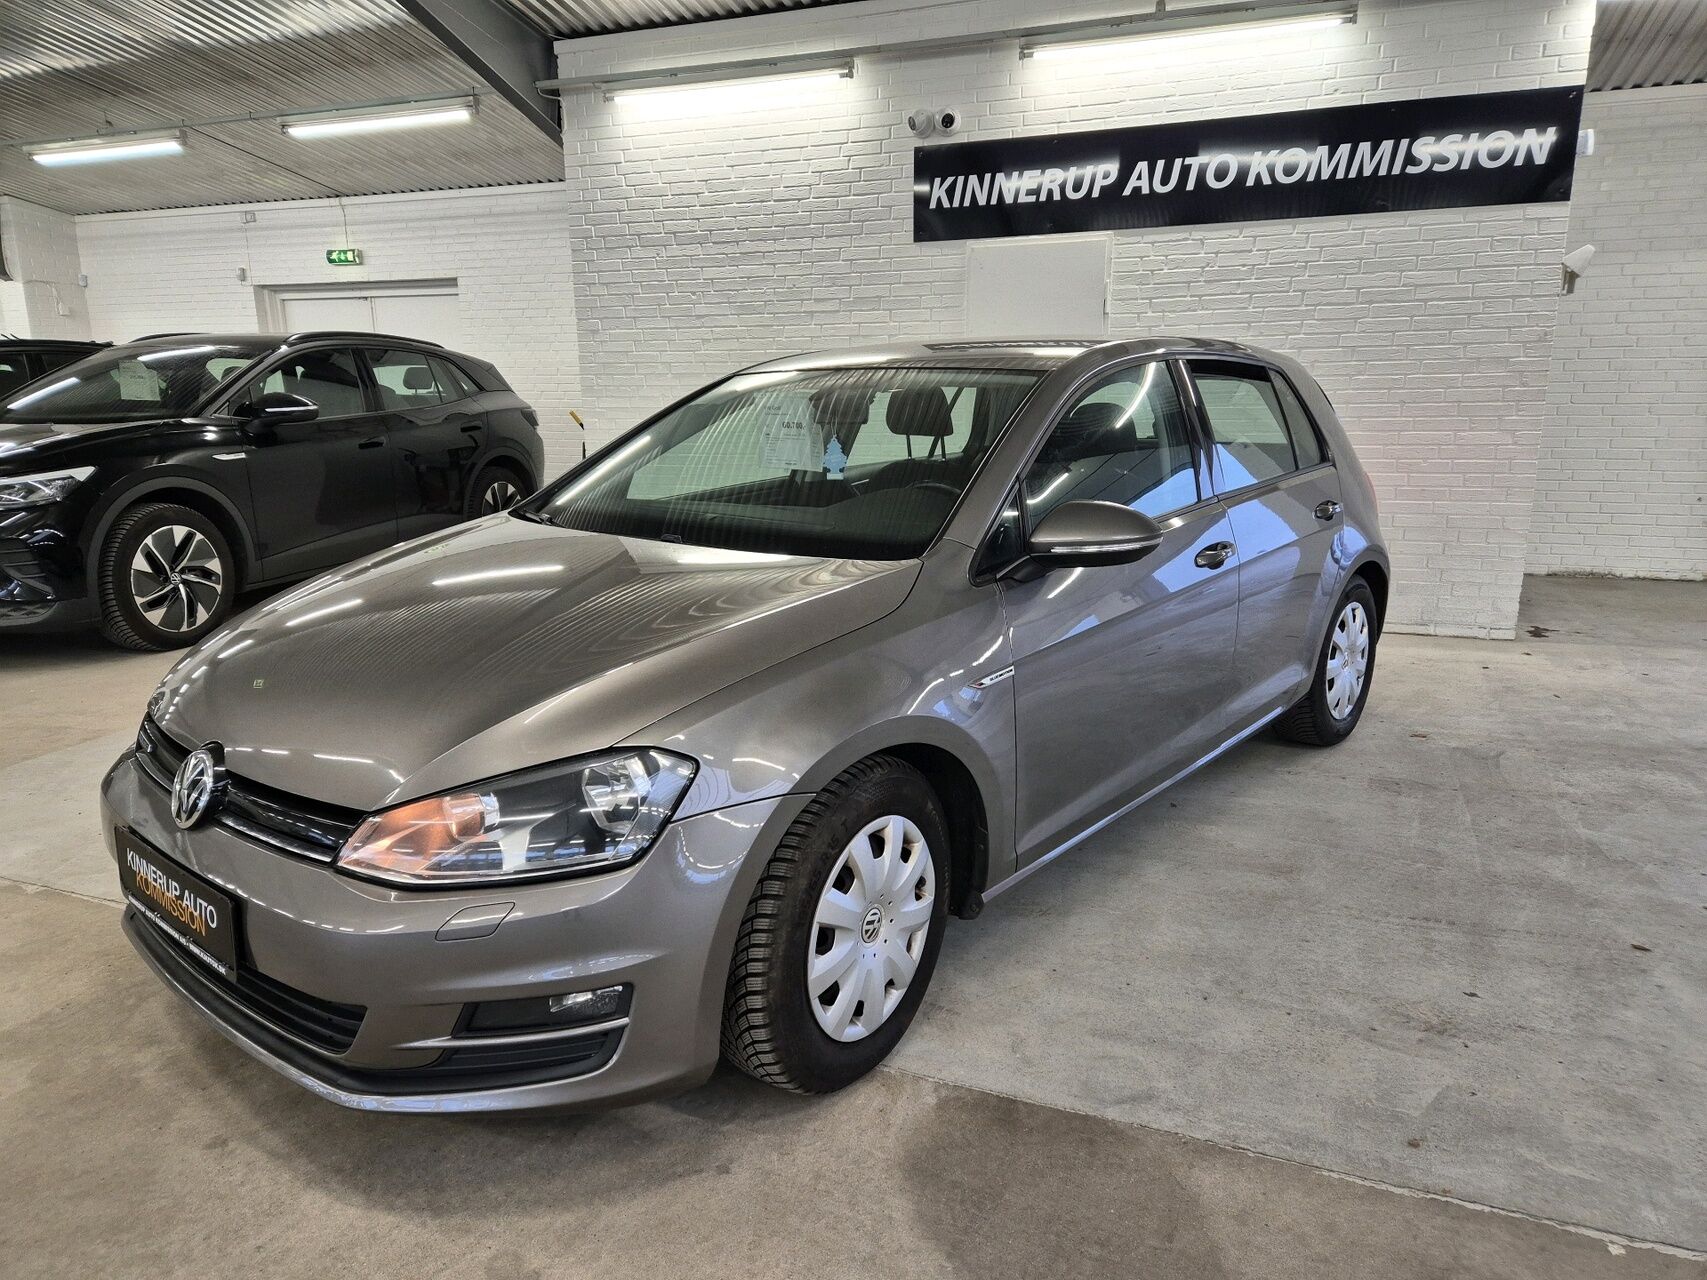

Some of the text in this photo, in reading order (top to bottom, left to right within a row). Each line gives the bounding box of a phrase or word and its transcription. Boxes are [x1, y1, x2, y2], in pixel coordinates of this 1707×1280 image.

[929, 126, 1557, 209] KINNERUP AUTO KOMMISSION
[126, 847, 217, 929] KINNERUP AUTO
[136, 872, 207, 937] KOMMISSION
